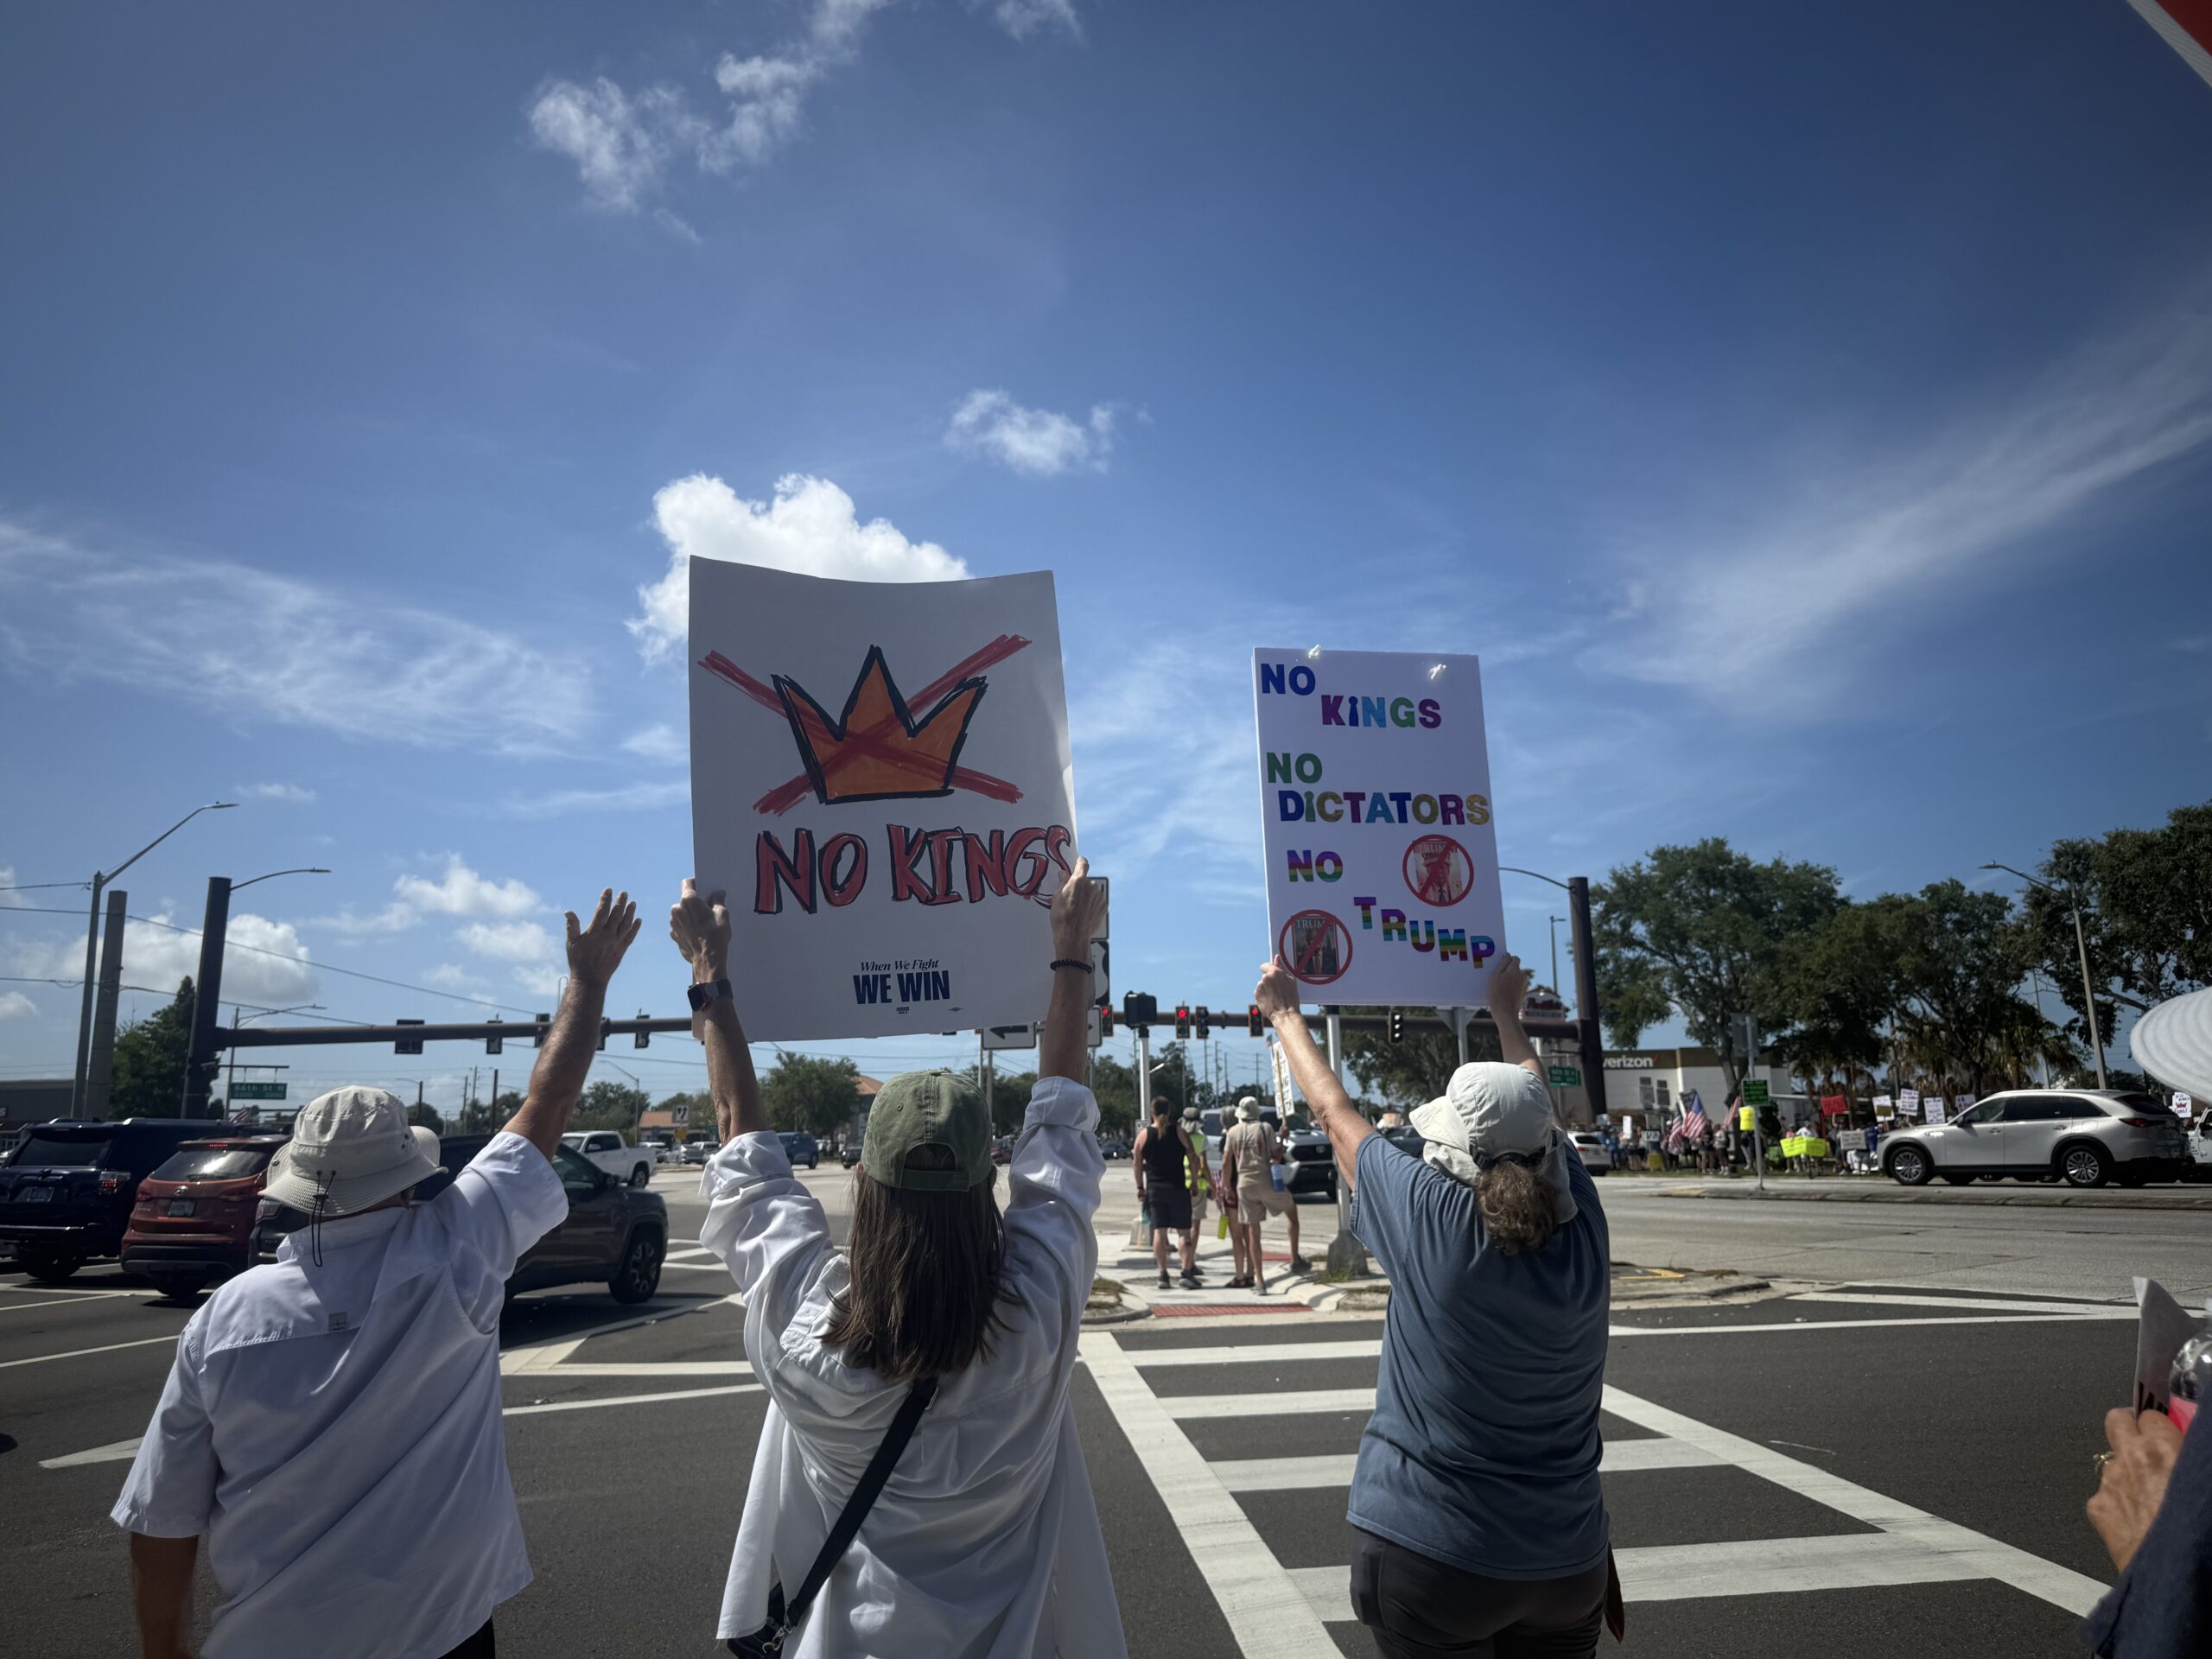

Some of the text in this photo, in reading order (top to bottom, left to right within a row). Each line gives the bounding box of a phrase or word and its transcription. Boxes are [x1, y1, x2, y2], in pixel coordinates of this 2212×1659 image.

[1260, 663, 1316, 696] NO
[1266, 752, 1323, 785] NO
[753, 823, 1071, 915] NO KINGS
[1287, 849, 1344, 883] NO
[1295, 918, 1331, 930] TRUM
[1353, 896, 1496, 969] TRUMP
[861, 958, 939, 971] When We Fight
[853, 969, 950, 1004] WE WIN
